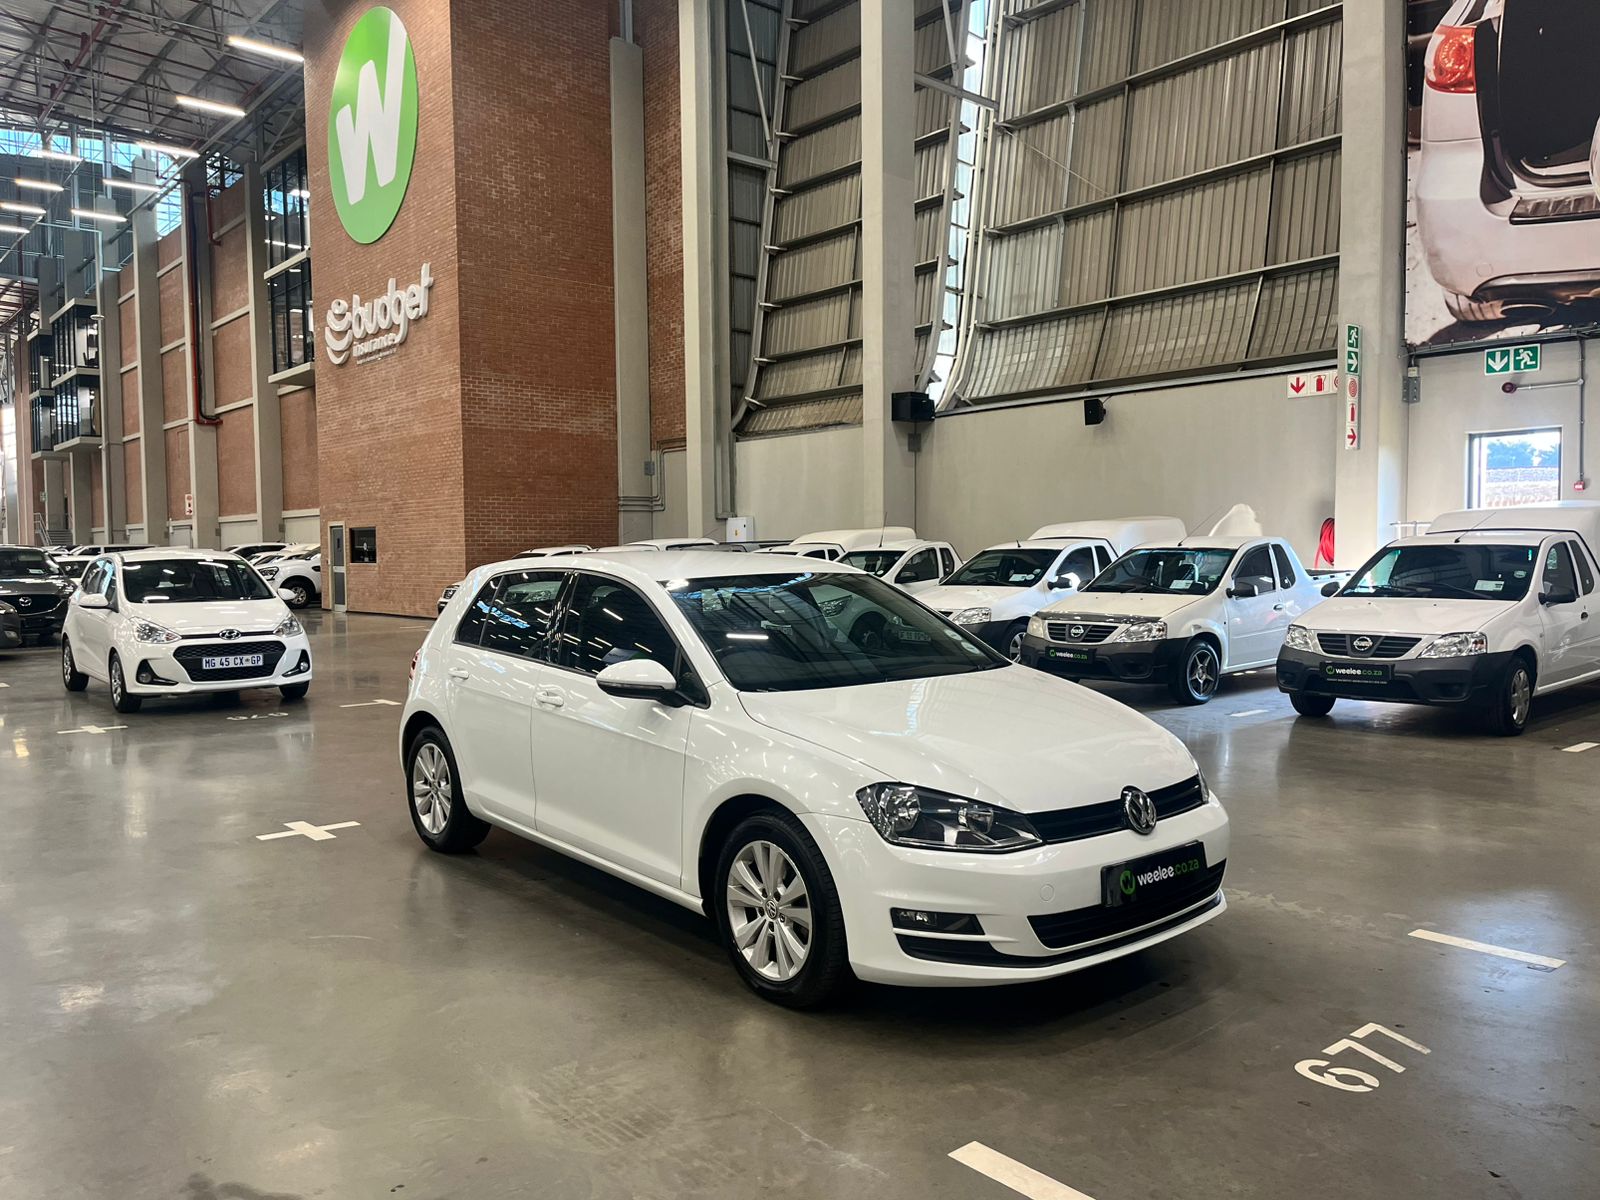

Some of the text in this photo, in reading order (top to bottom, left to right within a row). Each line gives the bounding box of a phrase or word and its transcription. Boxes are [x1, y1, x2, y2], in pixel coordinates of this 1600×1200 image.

[352, 262, 433, 344] budget
[219, 658, 230, 667] 45
[233, 656, 244, 666] CX
[250, 655, 261, 663] GP
[1137, 858, 1200, 886] weelee.co.za
[1294, 1022, 1432, 1093] 677
